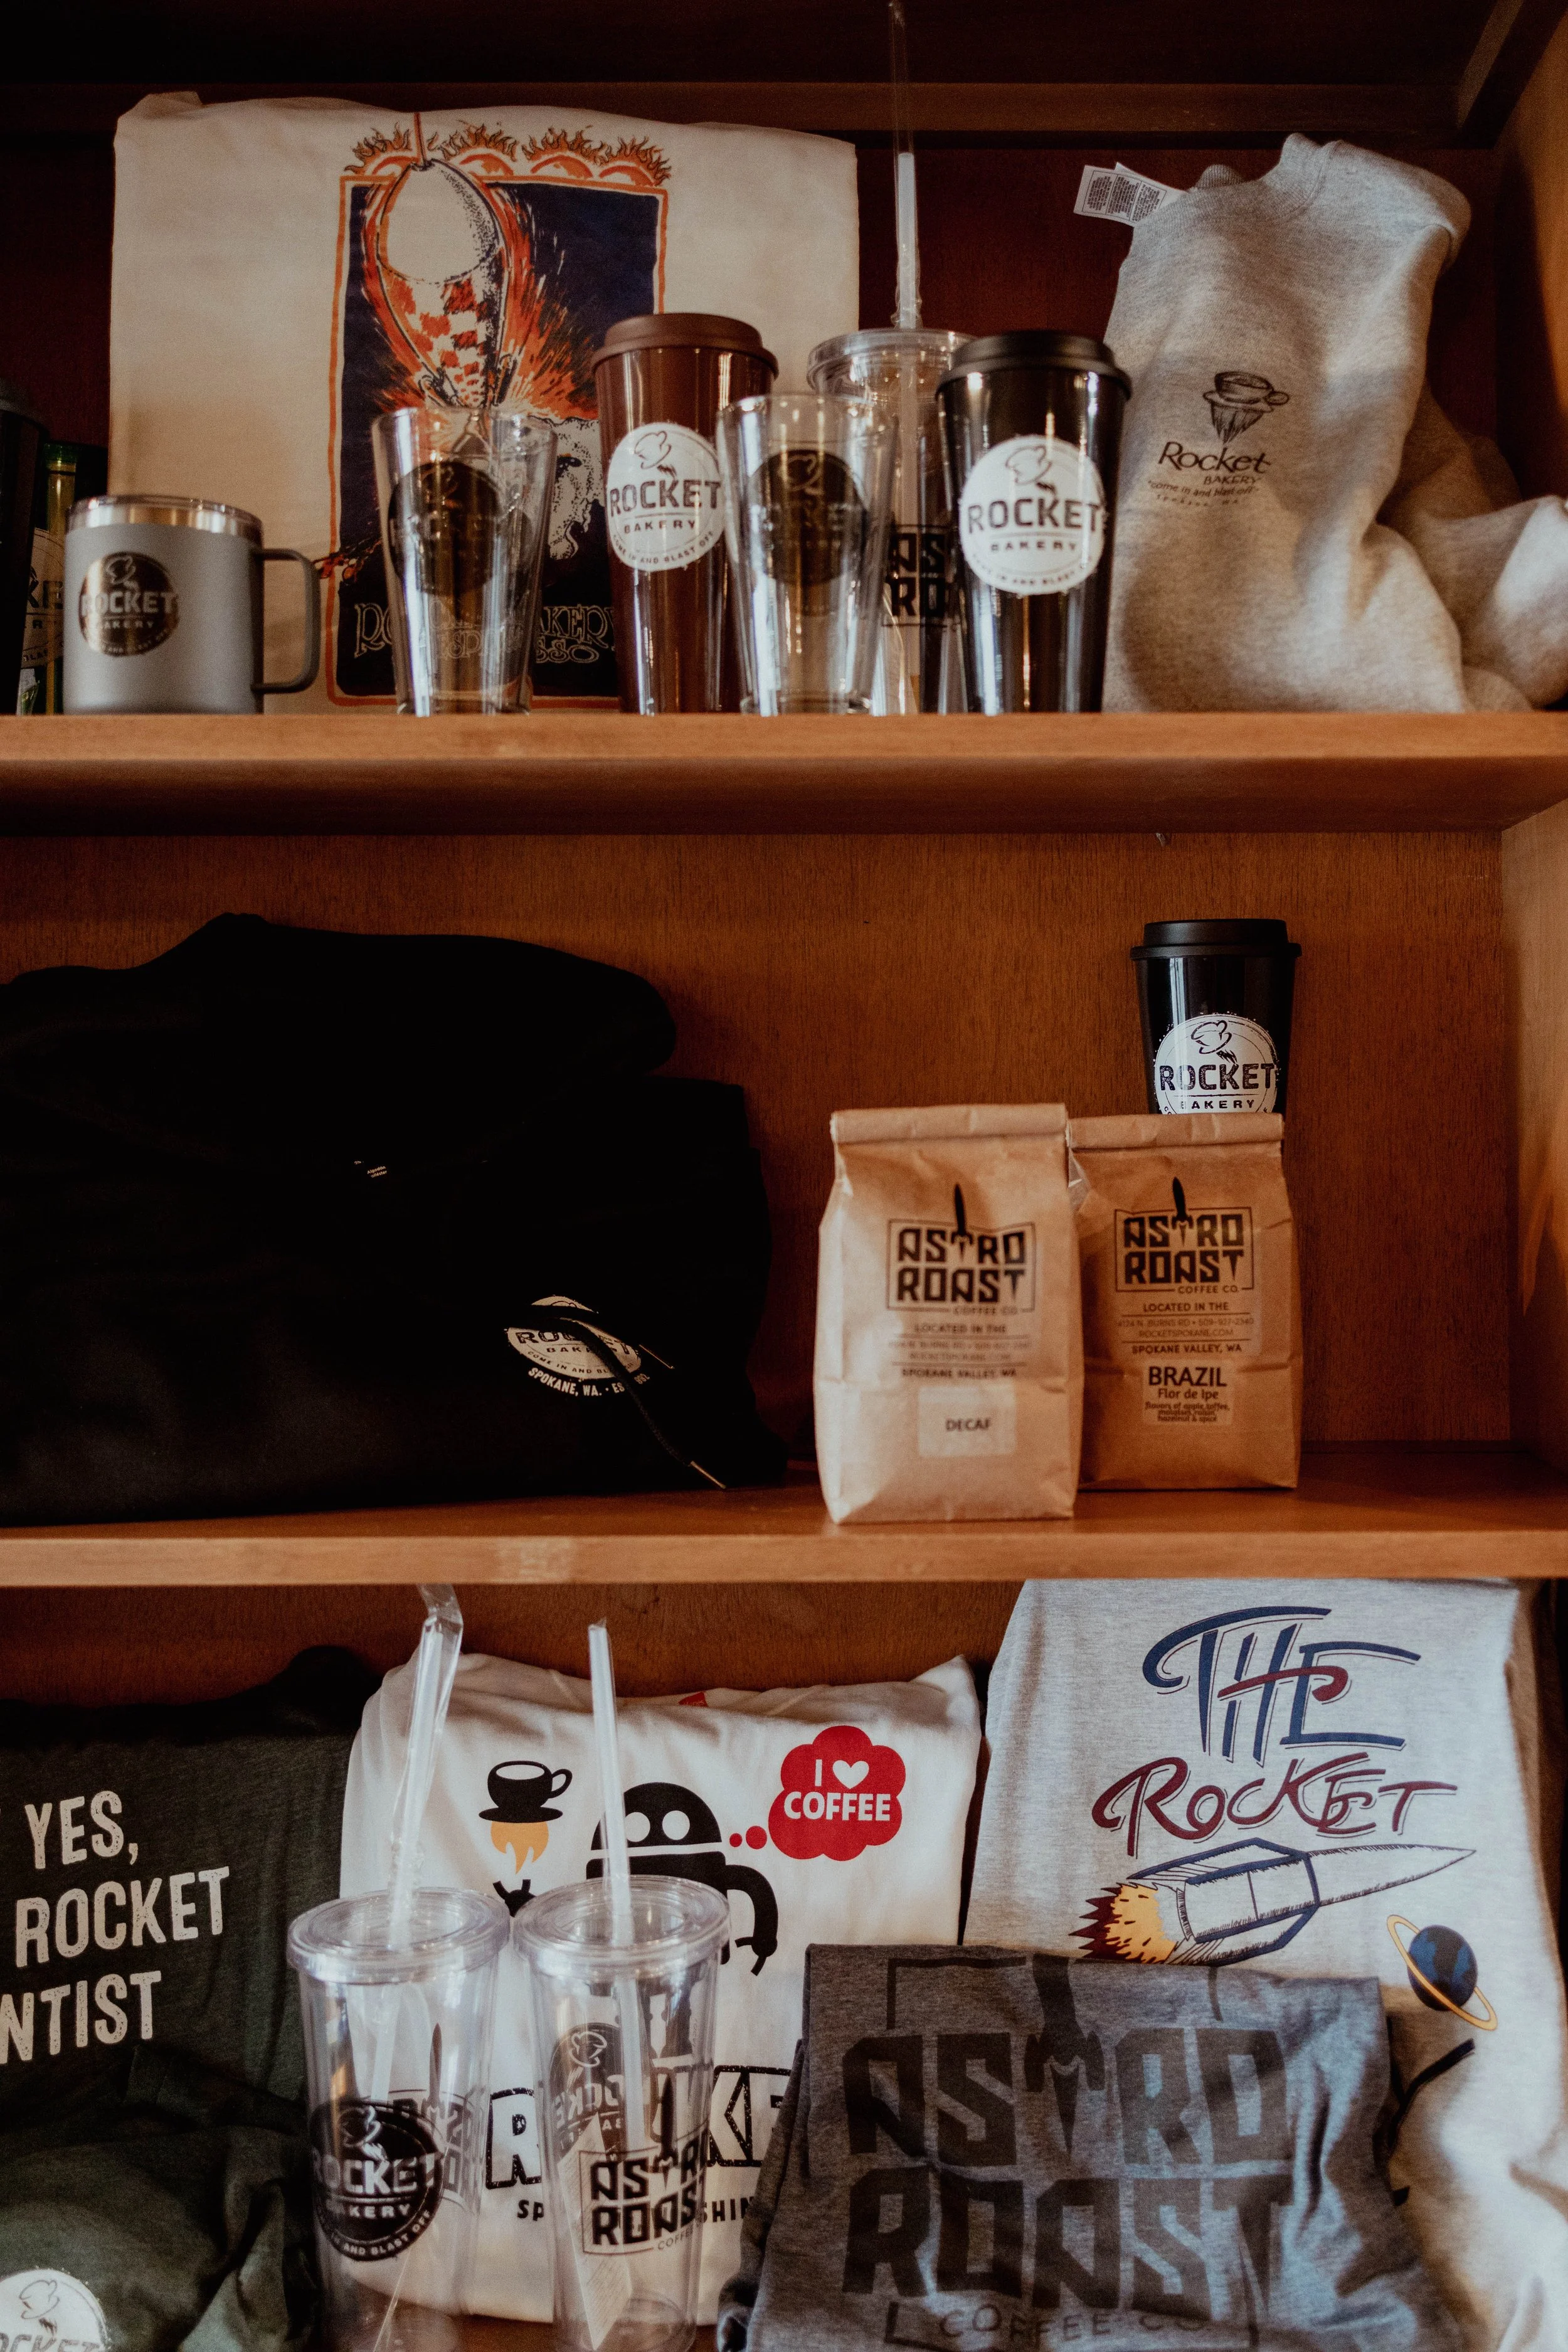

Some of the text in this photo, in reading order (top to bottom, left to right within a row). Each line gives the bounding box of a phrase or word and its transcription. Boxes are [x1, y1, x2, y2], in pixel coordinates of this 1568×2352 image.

[1158, 442, 1271, 474] Rocket
[1204, 475, 1262, 485] BAKERY
[610, 479, 721, 517] ROCKET
[624, 520, 695, 534] BAKERY
[968, 498, 1102, 534] ROCKET
[1159, 1062, 1276, 1091] ROCKET
[1124, 1249, 1245, 1284] ROAST
[897, 1267, 1025, 1303] ROAST
[1177, 1286, 1219, 1295] COFFEE
[1143, 1301, 1229, 1312] LOCATED IN THE
[527, 1351, 551, 1365] COME
[1131, 1344, 1180, 1355] SPOKANE
[1226, 1343, 1242, 1352] WA
[528, 1367, 578, 1397] SPOKANE,
[583, 1385, 602, 1396] WA.
[1148, 1366, 1227, 1387] BRAZIL
[1158, 1388, 1219, 1401] Flor de Ipe
[946, 1417, 992, 1433] DECAF
[1142, 1606, 1421, 1766] THE
[815, 1759, 823, 1787] I
[783, 1791, 891, 1821] COFFEE
[1092, 1752, 1458, 1857] ROCKET
[24, 1790, 138, 1870] YES,
[15, 1865, 230, 1968] ROCKET
[0, 1970, 162, 2065] NTIST
[591, 2181, 706, 2247] ROAS
[371, 2234, 409, 2255] BLAST
[841, 2166, 1295, 2323] ROAST
